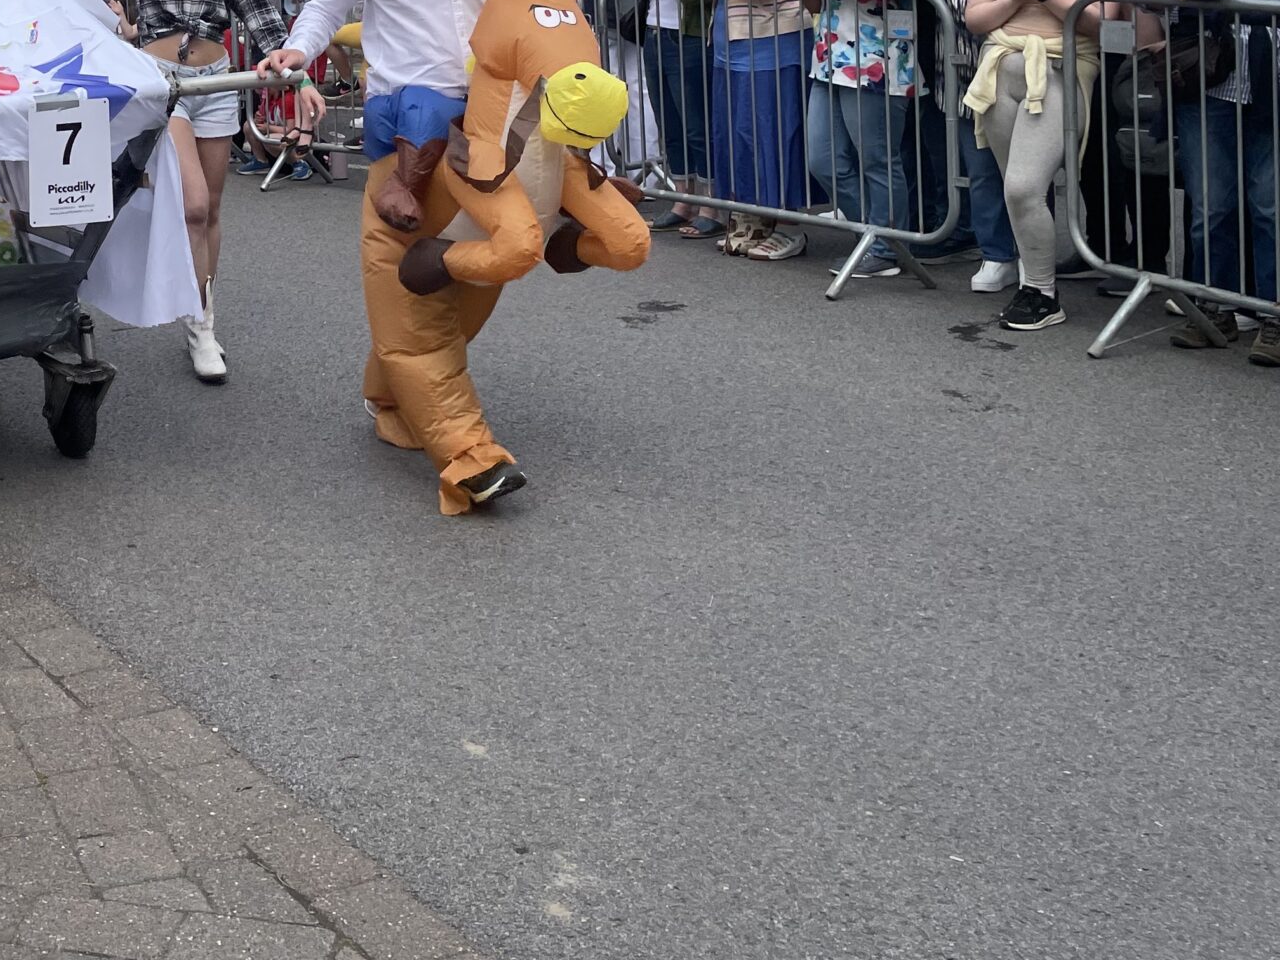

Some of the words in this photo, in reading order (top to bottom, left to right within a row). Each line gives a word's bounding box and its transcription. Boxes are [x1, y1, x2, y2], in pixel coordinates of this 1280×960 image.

[56, 122, 82, 165] 7
[48, 181, 96, 194] Piccadilly
[58, 195, 85, 204] KIA
